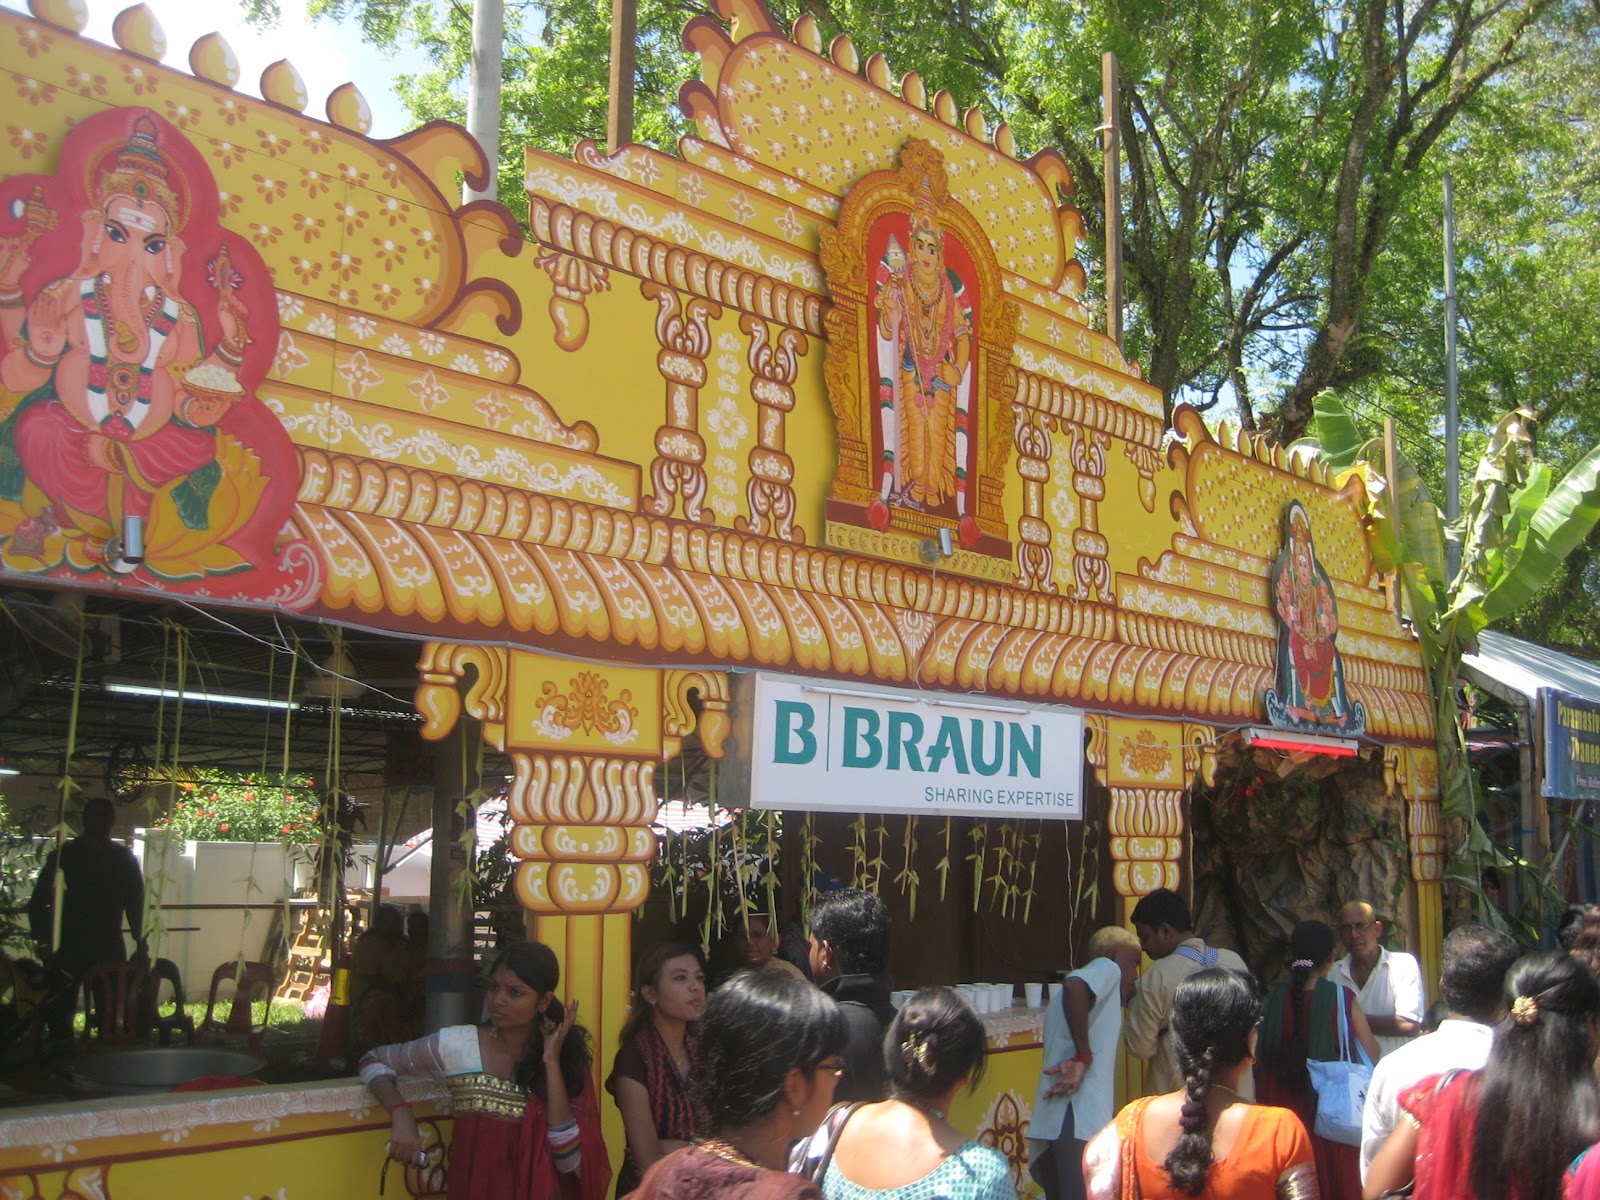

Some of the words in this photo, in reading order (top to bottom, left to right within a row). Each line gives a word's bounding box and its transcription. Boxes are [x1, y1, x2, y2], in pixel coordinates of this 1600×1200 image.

[772, 700, 817, 765] B
[841, 707, 1041, 778] BRAUN
[924, 786, 994, 804] SHARING
[997, 790, 1073, 806] EXPERTISE
